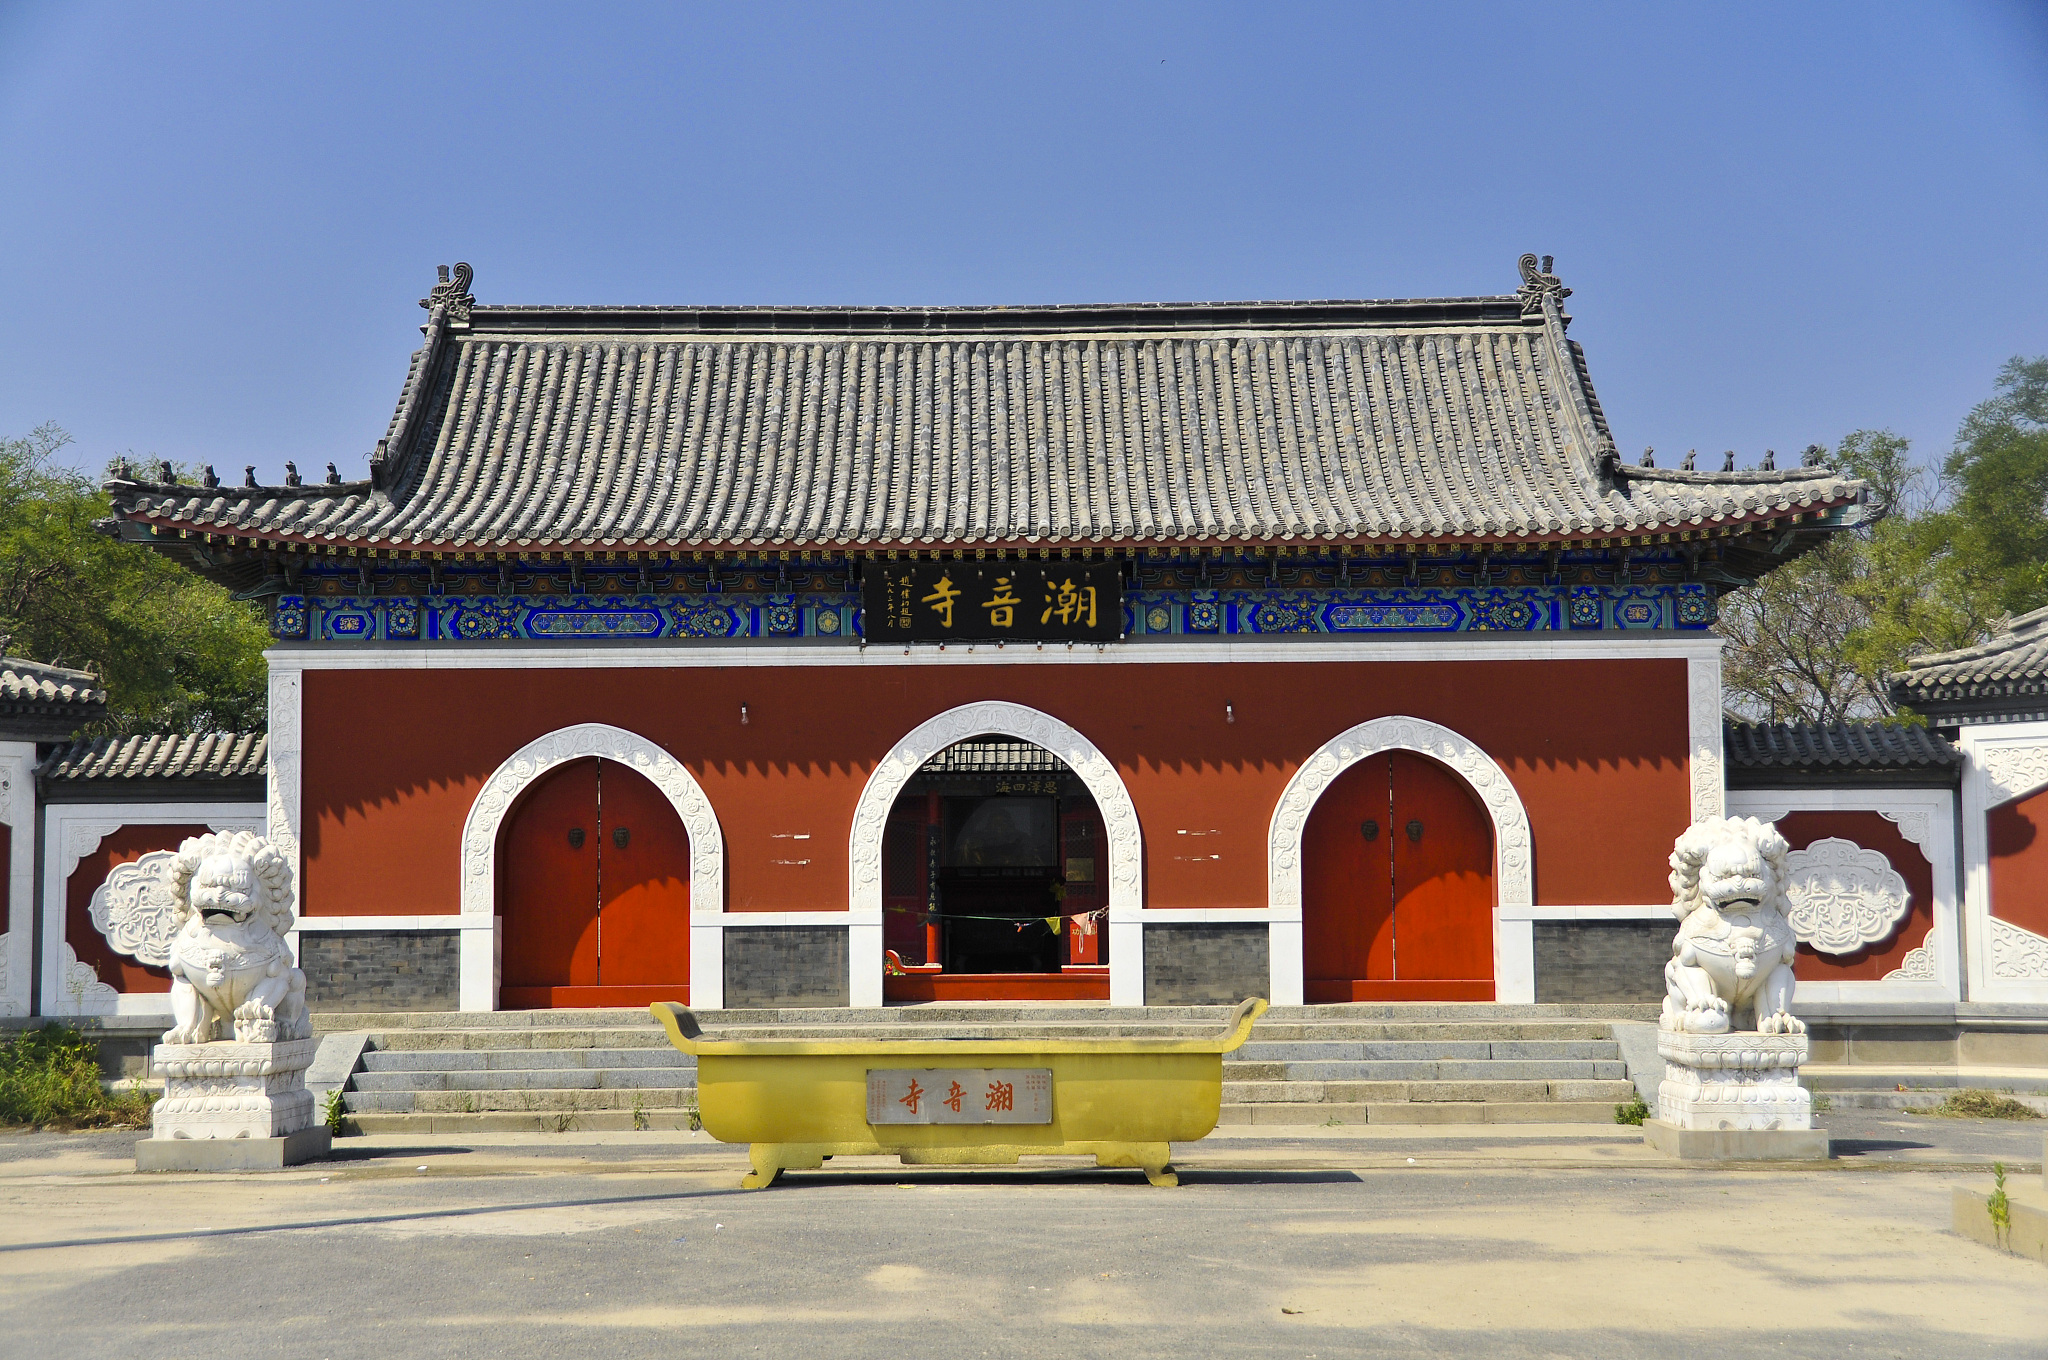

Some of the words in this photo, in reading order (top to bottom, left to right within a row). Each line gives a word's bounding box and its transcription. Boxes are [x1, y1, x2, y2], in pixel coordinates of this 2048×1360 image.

[921, 576, 1097, 628] 潮音寺
[899, 1078, 1013, 1115] 潮音寺
